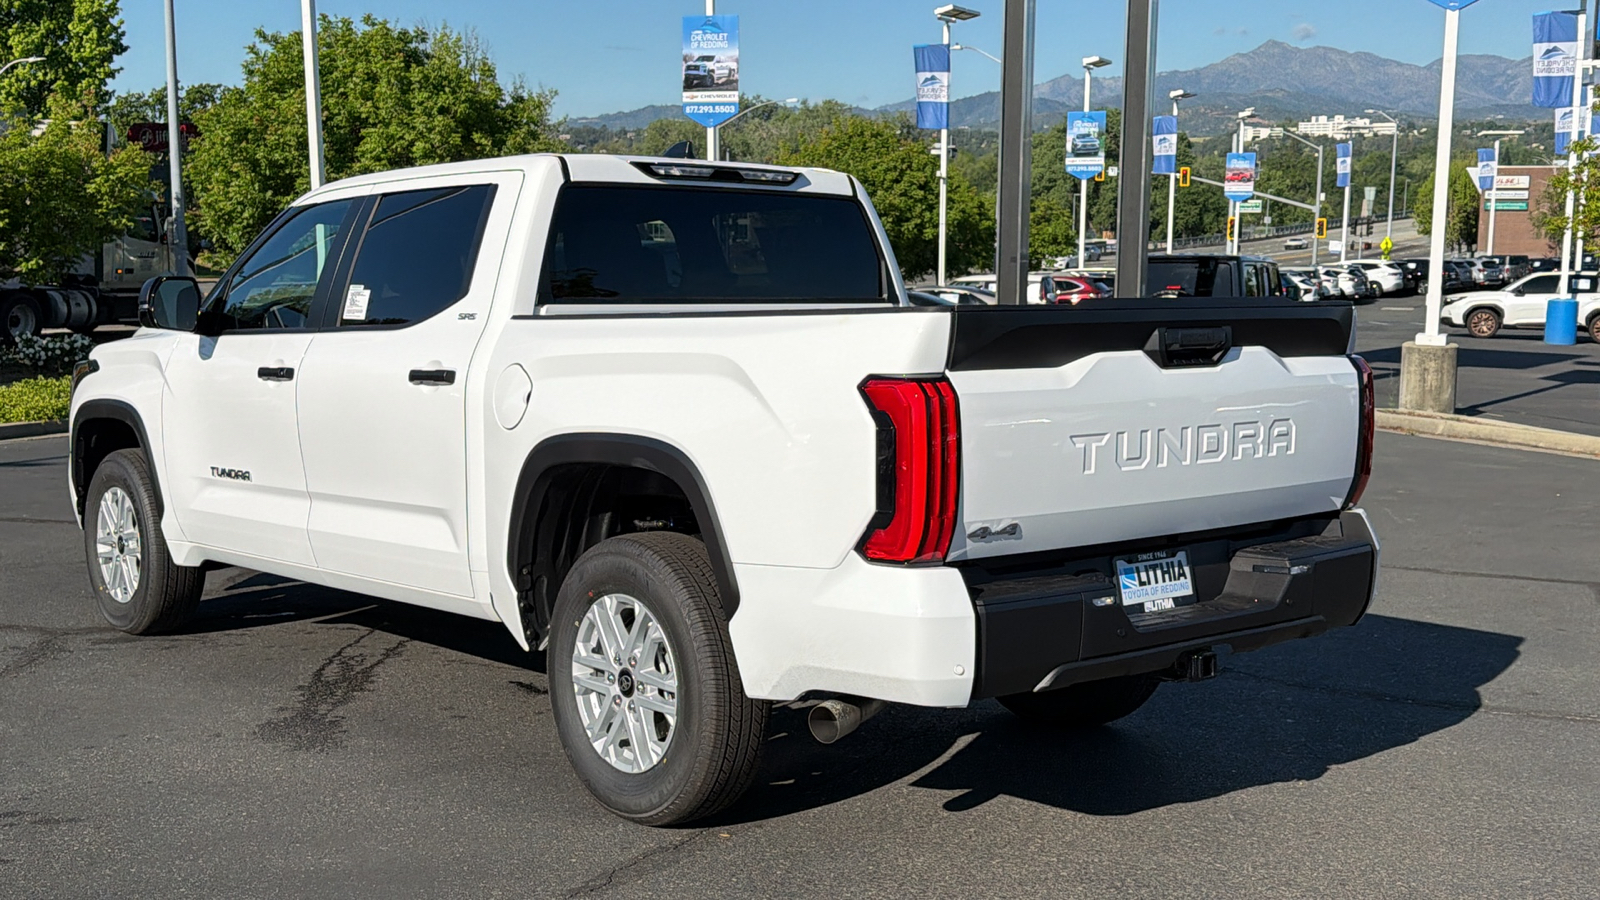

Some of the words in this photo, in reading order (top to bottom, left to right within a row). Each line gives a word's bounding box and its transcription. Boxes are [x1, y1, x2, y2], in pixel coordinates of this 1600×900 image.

[690, 32, 728, 41] CHEVROLET
[690, 41, 699, 49] OF
[700, 40, 728, 48] REDDING
[685, 105, 736, 114] 877.293.5503
[1069, 416, 1297, 475] TUNDRA
[210, 465, 252, 482] TUNDRA
[1137, 552, 1154, 560] SINCE
[1135, 559, 1188, 588] LITHIA
[1123, 589, 1150, 600] TOYOTA
[1150, 586, 1160, 596] OF
[1160, 581, 1190, 594] REDDING
[1151, 597, 1176, 611] LITHIA
